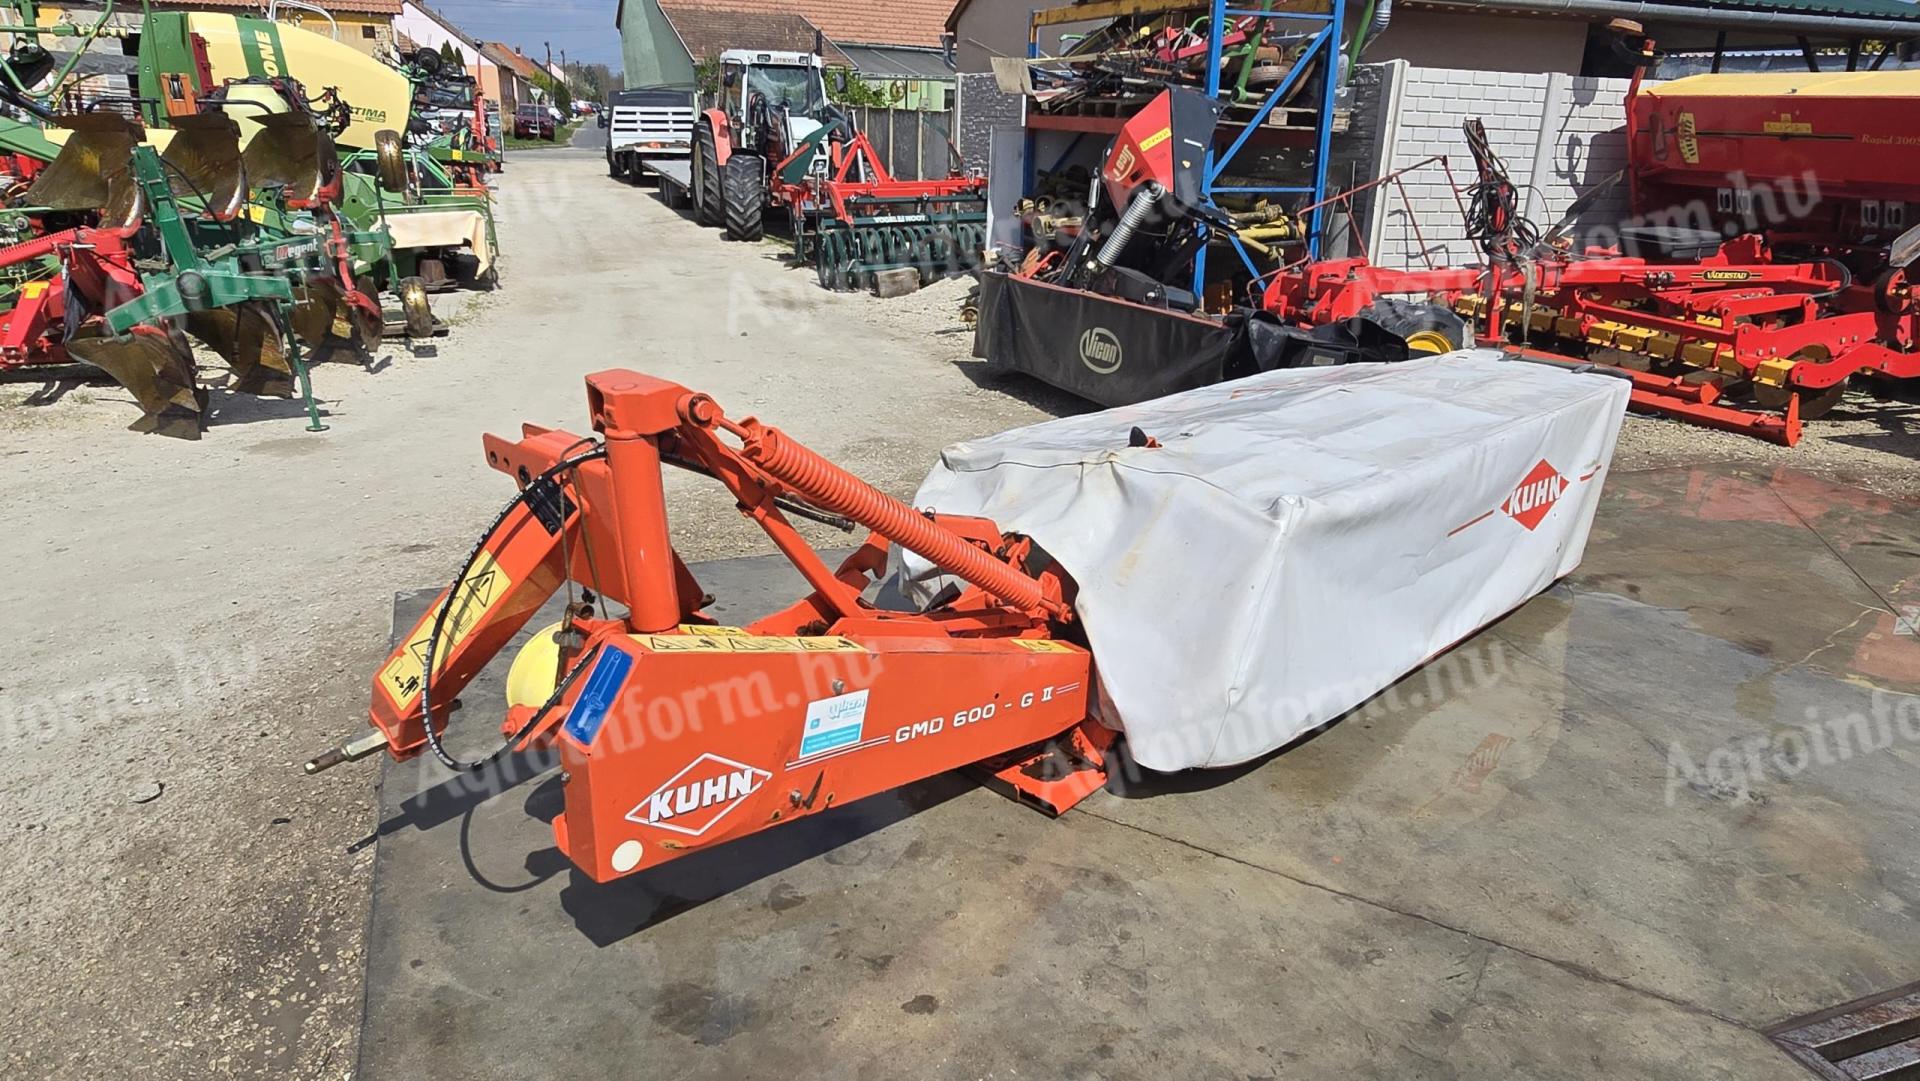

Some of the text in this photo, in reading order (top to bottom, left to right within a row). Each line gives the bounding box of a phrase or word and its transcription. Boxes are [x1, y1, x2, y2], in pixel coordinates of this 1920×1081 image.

[254, 29, 279, 79] ONE
[1084, 327, 1118, 364] Vicon
[1508, 472, 1561, 517] KUHN
[895, 717, 944, 743] GMD
[953, 703, 996, 728] 600
[1020, 692, 1034, 708] G
[648, 768, 754, 823] KUHN
